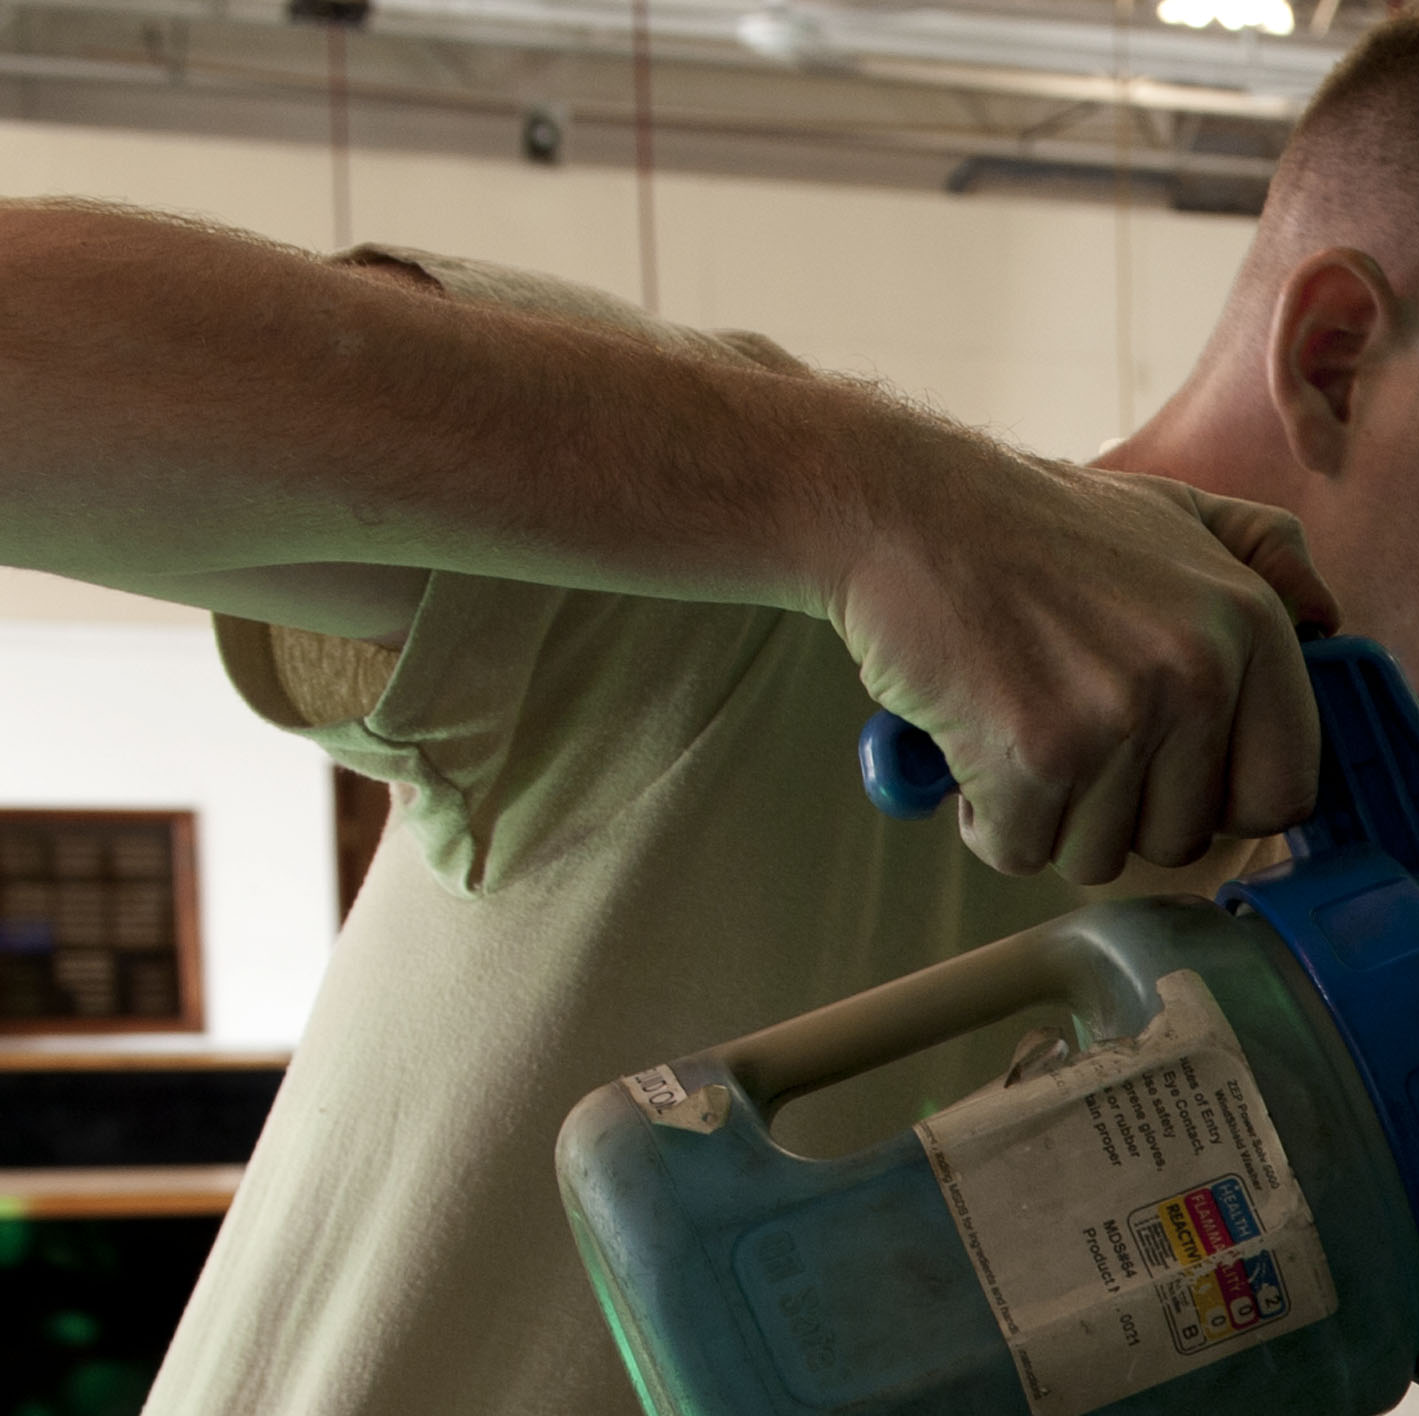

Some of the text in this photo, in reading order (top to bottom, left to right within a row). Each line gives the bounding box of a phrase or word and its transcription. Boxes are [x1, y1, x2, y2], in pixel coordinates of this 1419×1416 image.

[1149, 1096, 1179, 1140] safety
[1160, 1069, 1207, 1156] Eye Contact,
[1193, 1091, 1208, 1107] of
[1226, 1078, 1244, 1103] ZEP
[1236, 1103, 1258, 1138] Power
[1093, 1121, 1122, 1169] proper
[1106, 1094, 1120, 1111] or
[1114, 1111, 1142, 1159] rubber
[1138, 1121, 1169, 1172] gloves,
[1198, 1107, 1224, 1147] Entry
[1239, 1149, 1264, 1192] Washer
[961, 1215, 975, 1231] for
[1218, 1182, 1281, 1309] HEALTH 2
[1082, 1226, 1116, 1286] Product
[1190, 1192, 1254, 1317] FLAMMALITY 0
[1181, 1323, 1200, 1340] B
[1209, 1313, 1227, 1328] 0
